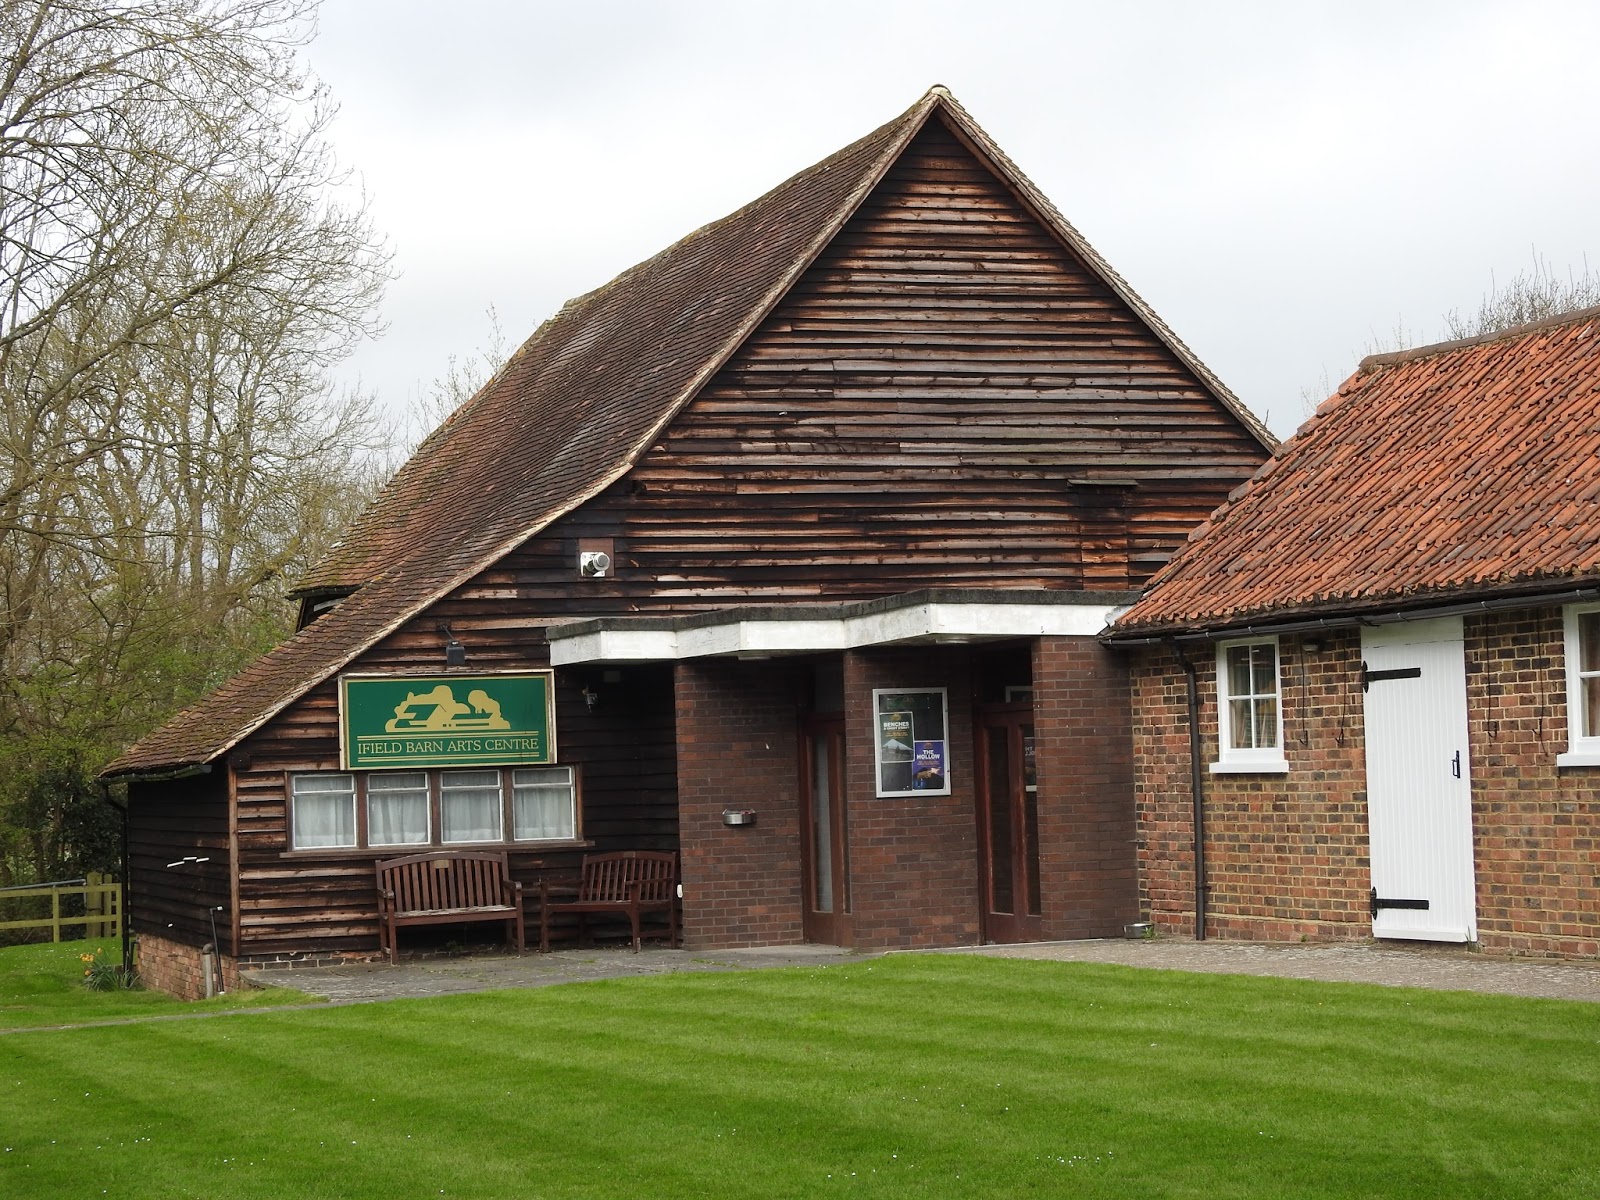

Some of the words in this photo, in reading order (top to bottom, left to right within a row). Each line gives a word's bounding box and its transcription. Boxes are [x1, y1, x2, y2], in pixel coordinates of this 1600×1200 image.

[358, 742, 402, 755] IFIELD
[406, 741, 443, 753] BARN
[447, 740, 481, 752] ARTS
[485, 738, 539, 751] CENTRE
